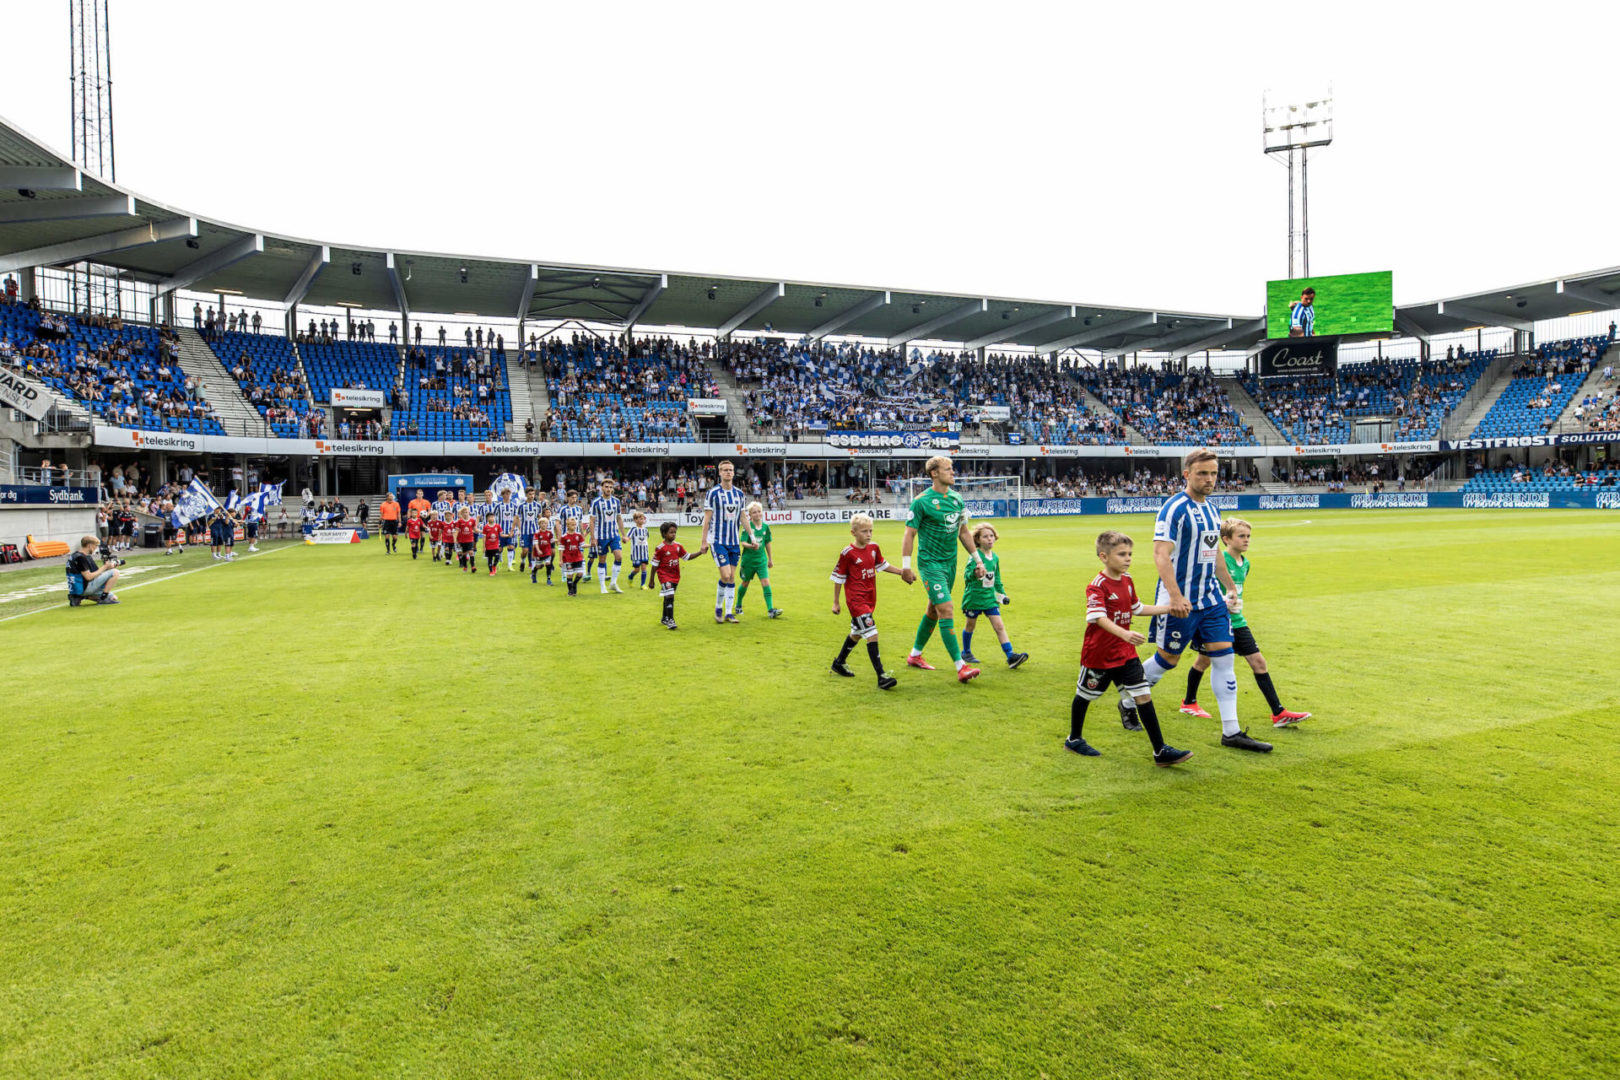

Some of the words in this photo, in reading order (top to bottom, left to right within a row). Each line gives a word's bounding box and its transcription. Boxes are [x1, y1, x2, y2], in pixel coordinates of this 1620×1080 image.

[1272, 347, 1324, 368] Coast
[0, 387, 33, 410] NSEN
[346, 395, 381, 403] telesikring
[145, 436, 196, 449] telesikring
[830, 434, 902, 447] ESBJERG
[1448, 435, 1558, 450] VESTFROST
[333, 444, 384, 455] telesikring
[493, 446, 539, 455] telesikring
[627, 446, 669, 455] telesikring
[749, 446, 787, 455] telesikring
[1049, 448, 1079, 456] telesikring
[1305, 447, 1341, 455] telesikring
[1394, 443, 1432, 452] telesikring
[49, 489, 84, 503] Sydbank
[685, 513, 705, 526] Toy
[765, 510, 792, 522] Lund
[800, 510, 836, 523] Toyota
